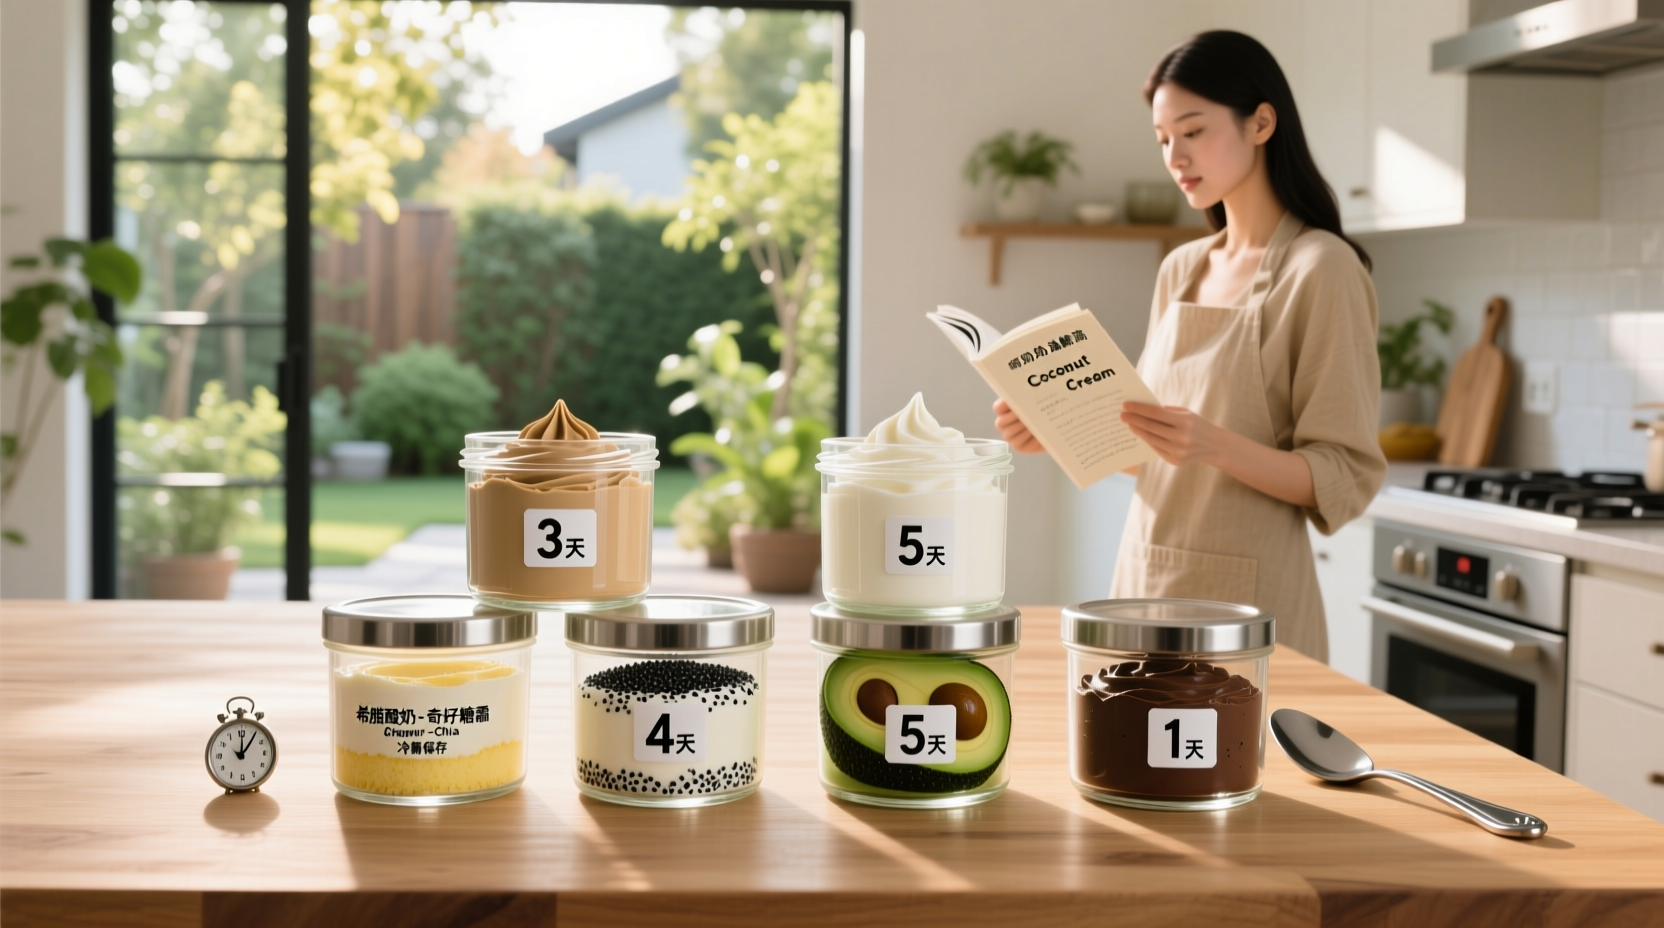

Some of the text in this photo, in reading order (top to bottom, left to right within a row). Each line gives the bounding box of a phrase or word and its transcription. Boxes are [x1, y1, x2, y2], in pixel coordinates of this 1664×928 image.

[1027, 355, 1091, 387] Coconut
[1066, 368, 1116, 391] Cream
[537, 518, 584, 559] 3天
[899, 525, 945, 566] 5天
[646, 713, 695, 754] 4天
[900, 715, 946, 755] 5天
[1165, 719, 1204, 759] 1天
